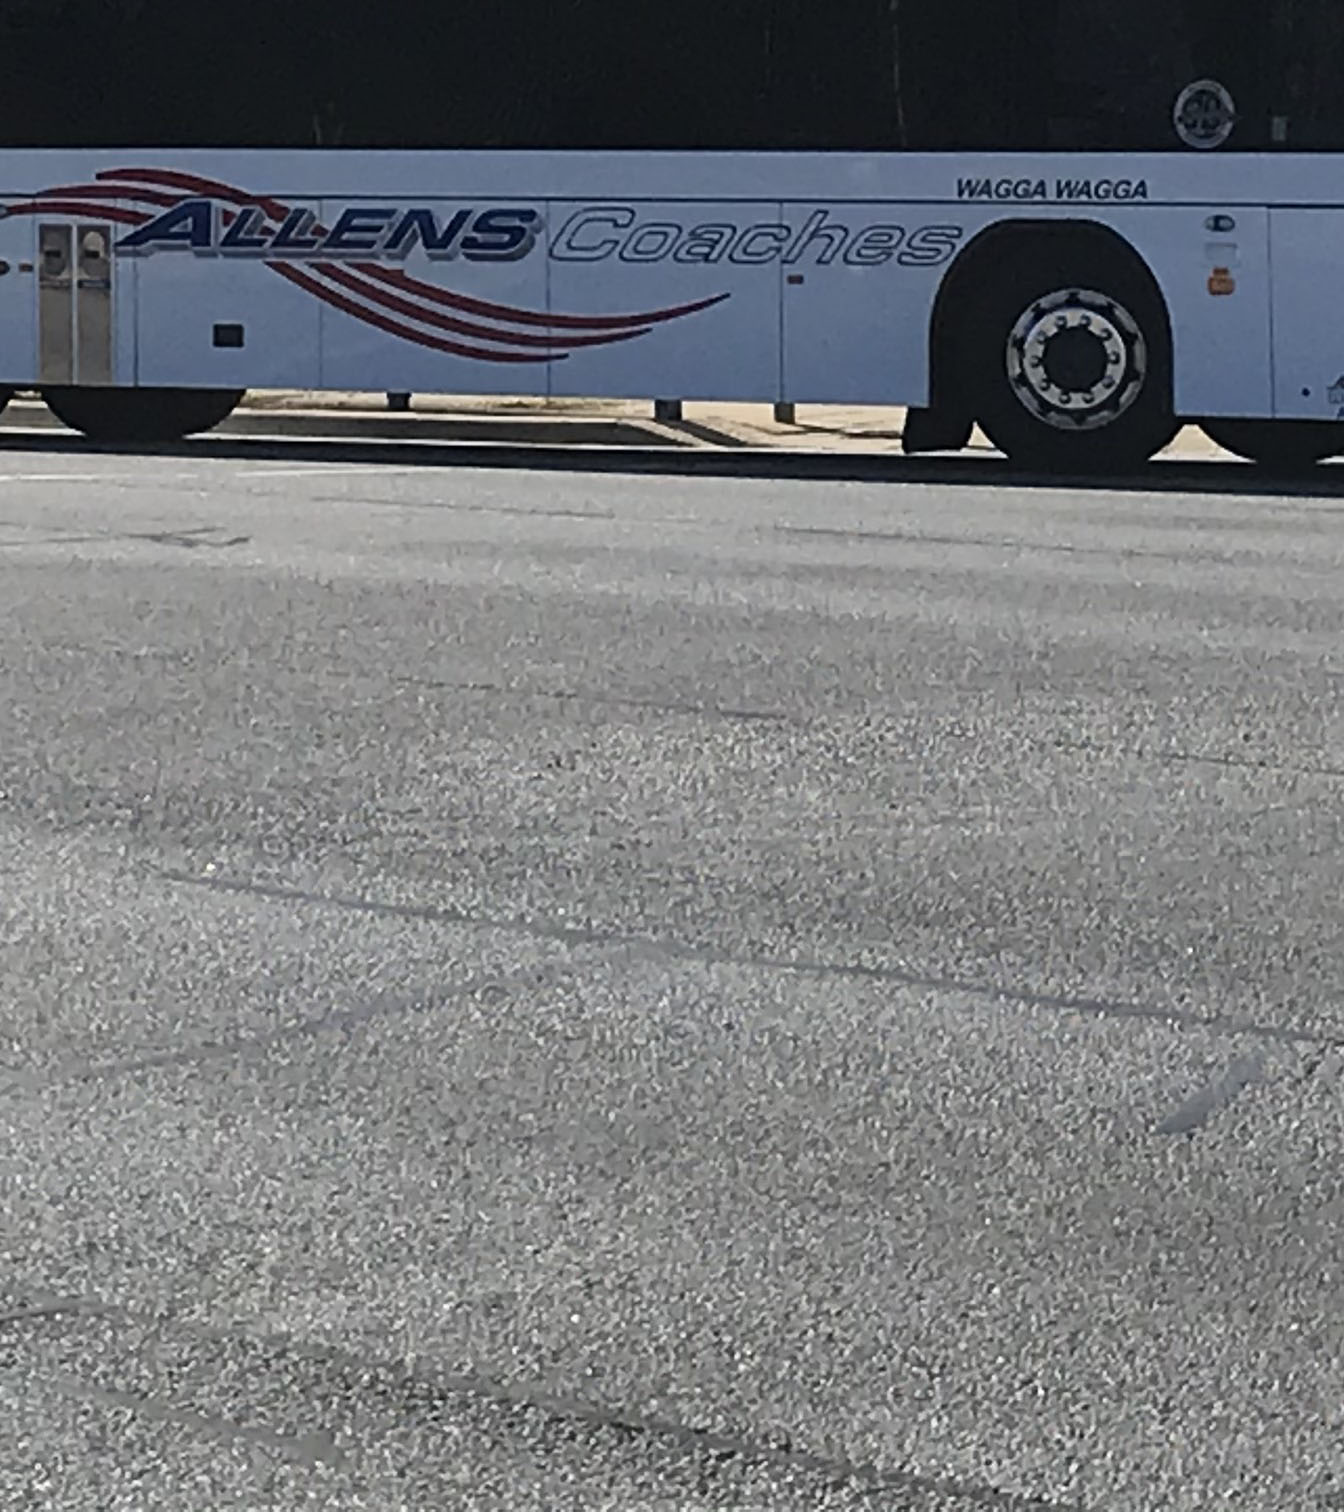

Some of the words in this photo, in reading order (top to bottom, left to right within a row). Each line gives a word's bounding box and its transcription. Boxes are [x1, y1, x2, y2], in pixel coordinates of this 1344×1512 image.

[956, 178, 1047, 200] WAGGA
[1056, 178, 1149, 200] WAGGA
[113, 199, 545, 263] ALLENS
[547, 205, 964, 266] Coaches
